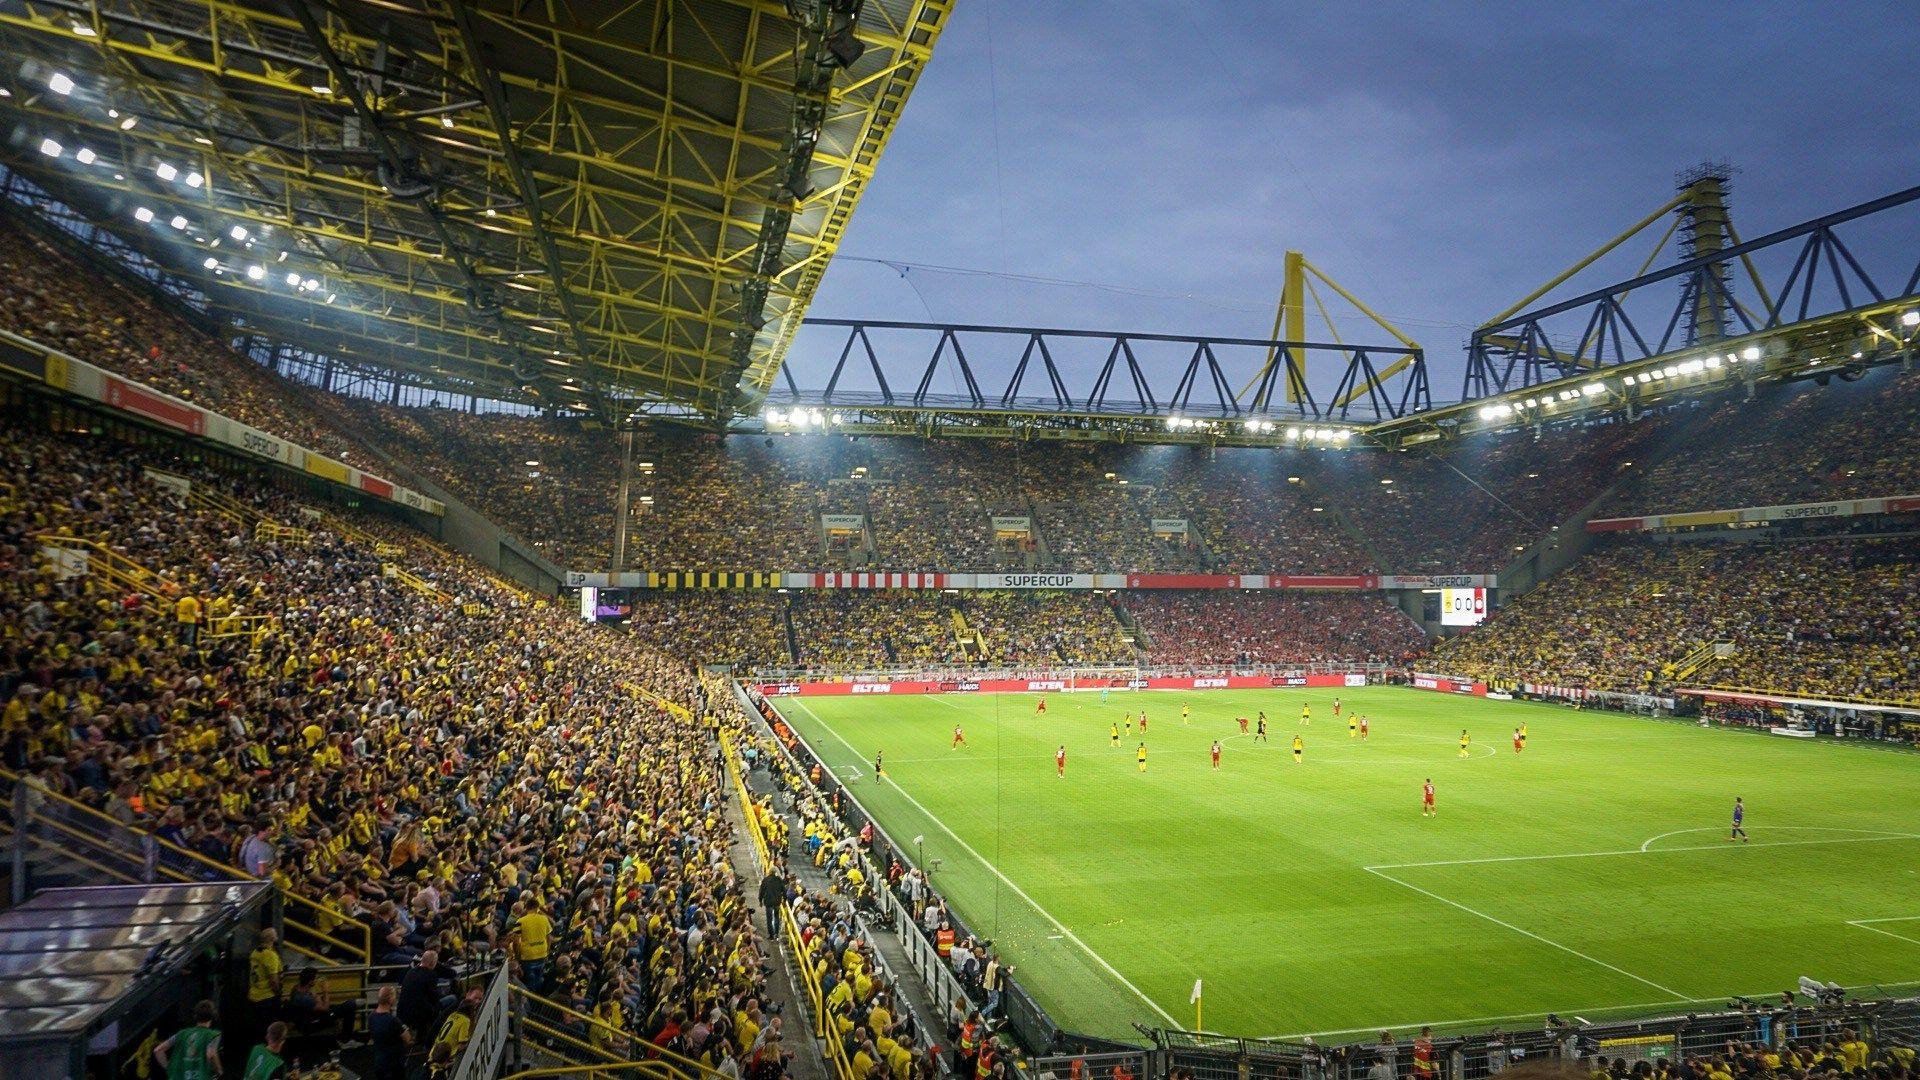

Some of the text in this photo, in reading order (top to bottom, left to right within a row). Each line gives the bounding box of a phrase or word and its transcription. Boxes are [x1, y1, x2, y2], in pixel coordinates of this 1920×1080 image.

[244, 431, 280, 457] SUPERCUP
[1784, 505, 1838, 518] SUPERCUP
[1005, 575, 1074, 587] SUPERCUP
[1429, 576, 1472, 587] SUPERCUP
